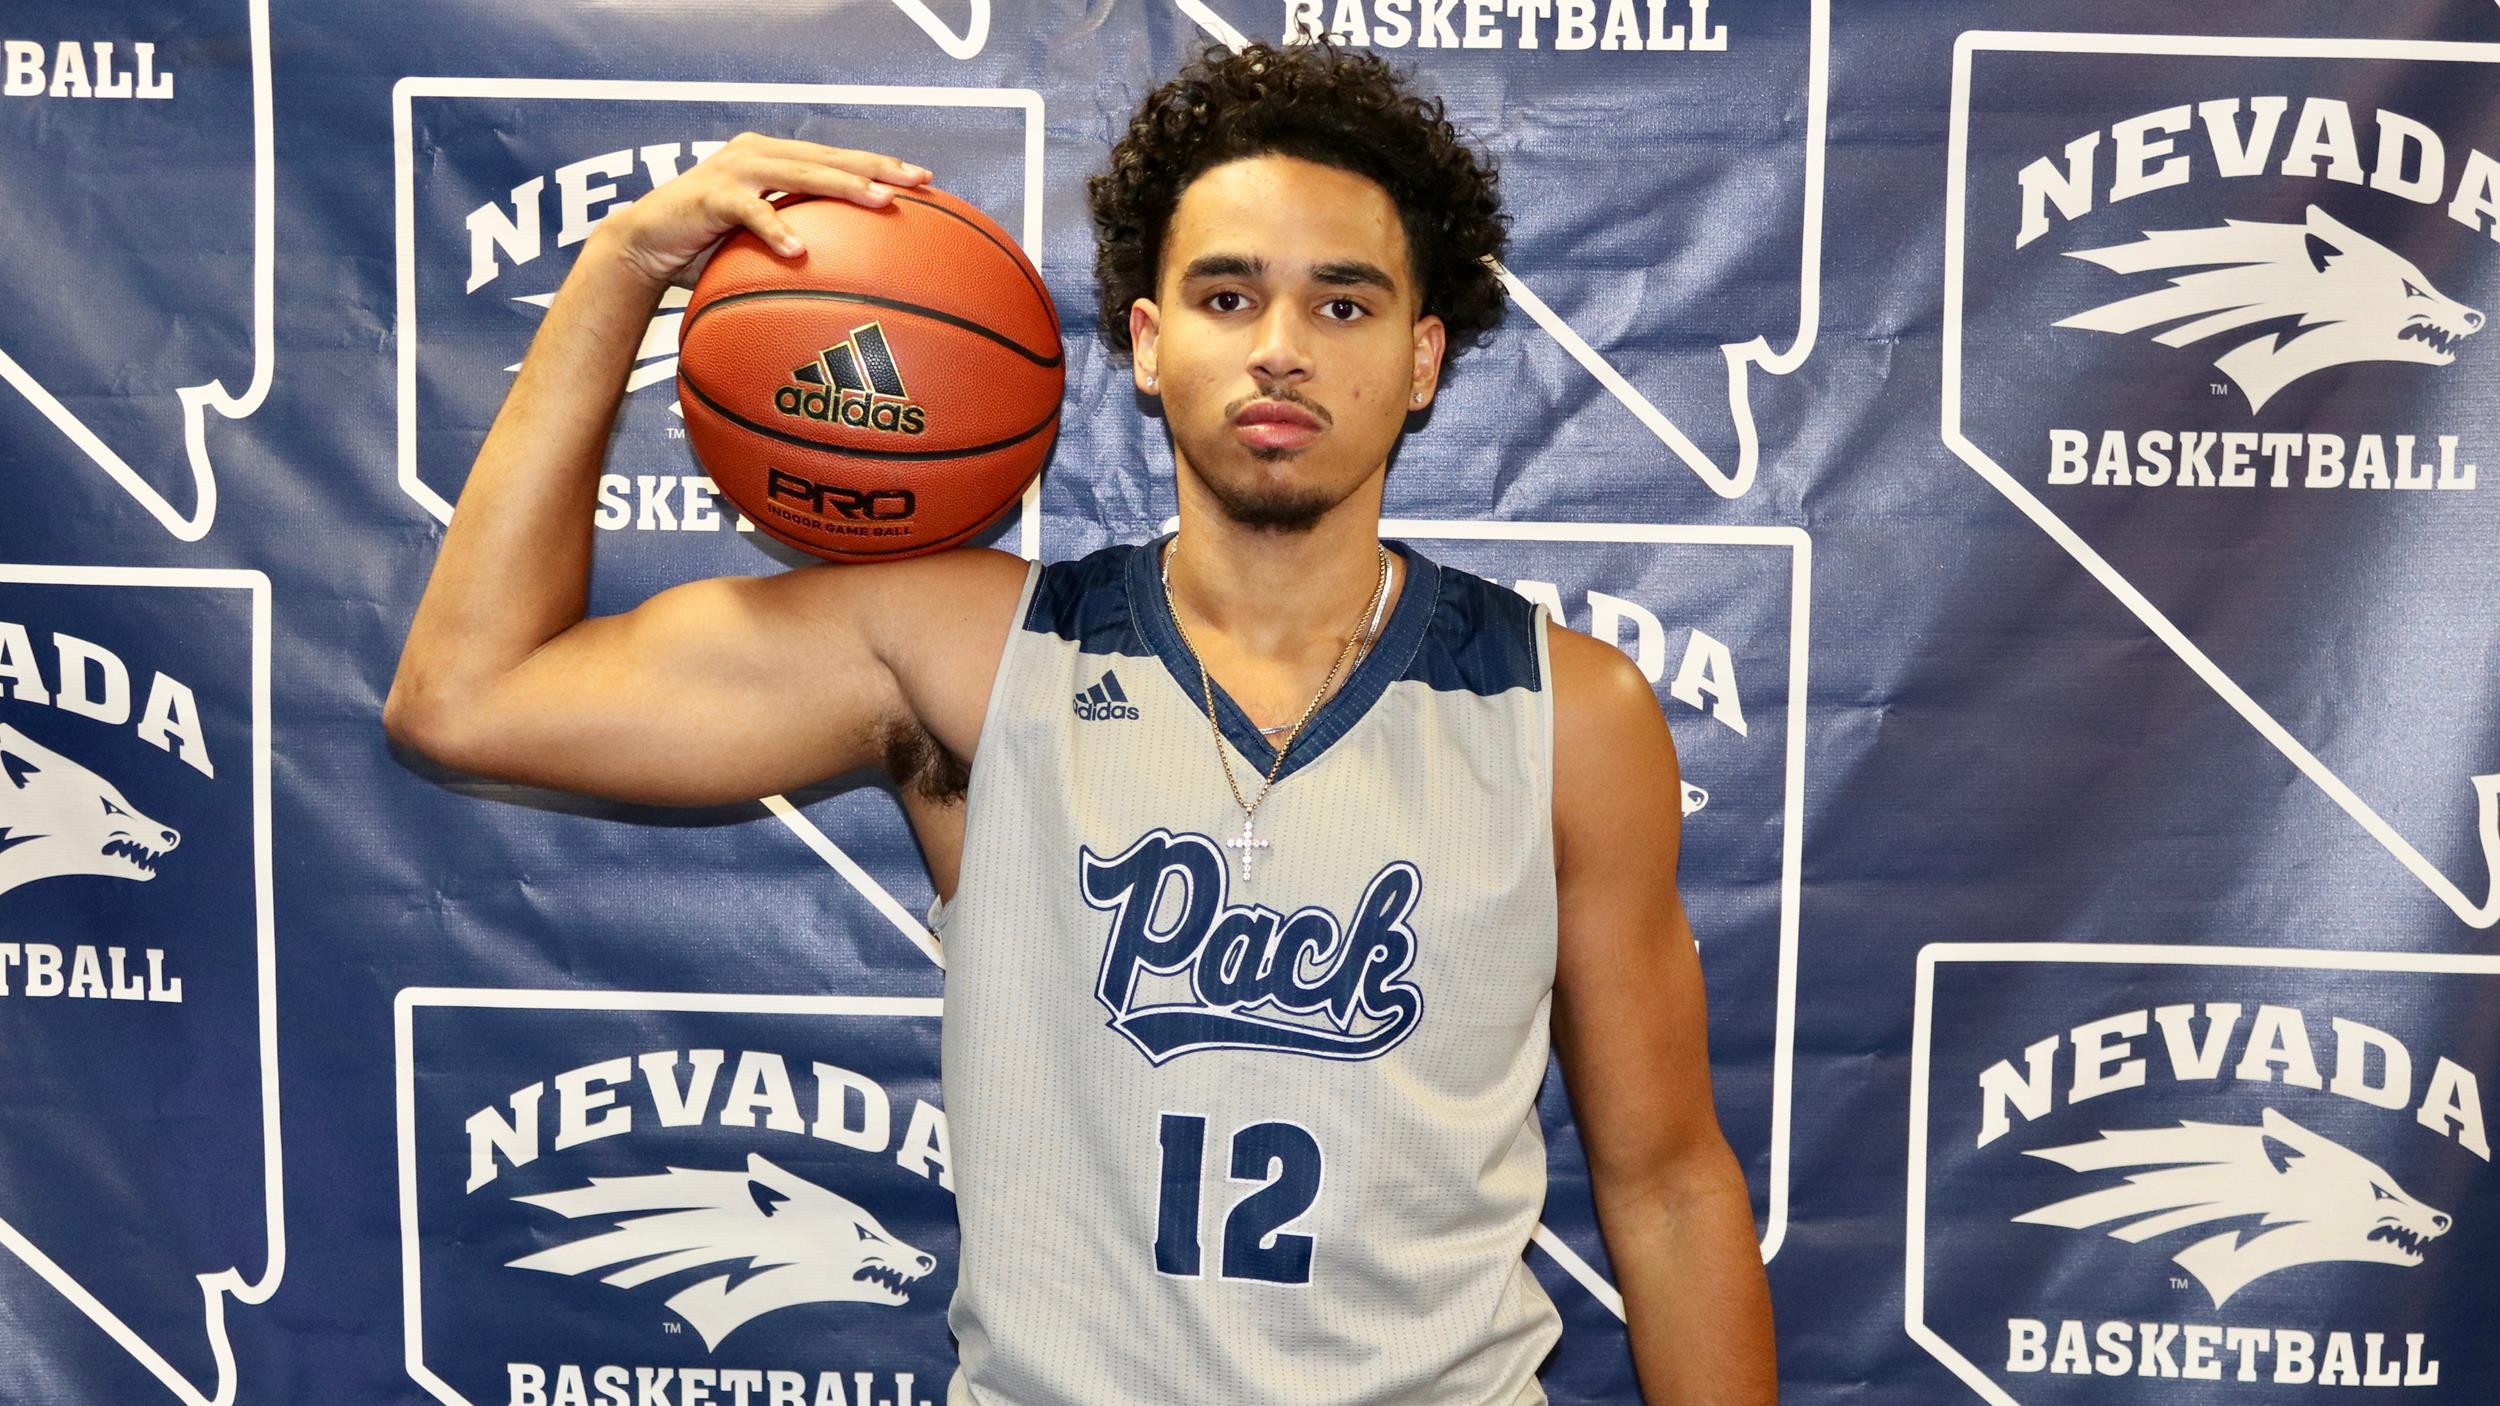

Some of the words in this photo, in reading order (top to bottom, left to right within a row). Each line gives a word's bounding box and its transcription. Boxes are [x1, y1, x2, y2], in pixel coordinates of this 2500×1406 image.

[1282, 0, 1728, 51] BASKETBALL
[2015, 96, 2500, 250] NEVADA
[774, 384, 926, 435] adidas
[2210, 384, 2228, 395] TM
[666, 427, 686, 440] TM
[2047, 429, 2477, 491] BASKETBALL
[594, 473, 756, 532] SKE
[767, 503, 822, 529] INDOOR
[825, 523, 869, 537] GAME
[873, 526, 914, 537] BALL
[768, 466, 916, 521] PRO
[1072, 699, 1140, 721] adidas
[1079, 827, 1425, 1067] Pack
[1977, 1002, 2490, 1162] NEVADA
[465, 1049, 956, 1194] NEVADA
[1152, 1110, 1325, 1286] 12
[2169, 1277, 2189, 1290] TM
[662, 1322, 682, 1334] TM
[2006, 1319, 2439, 1387] BASKETBALL
